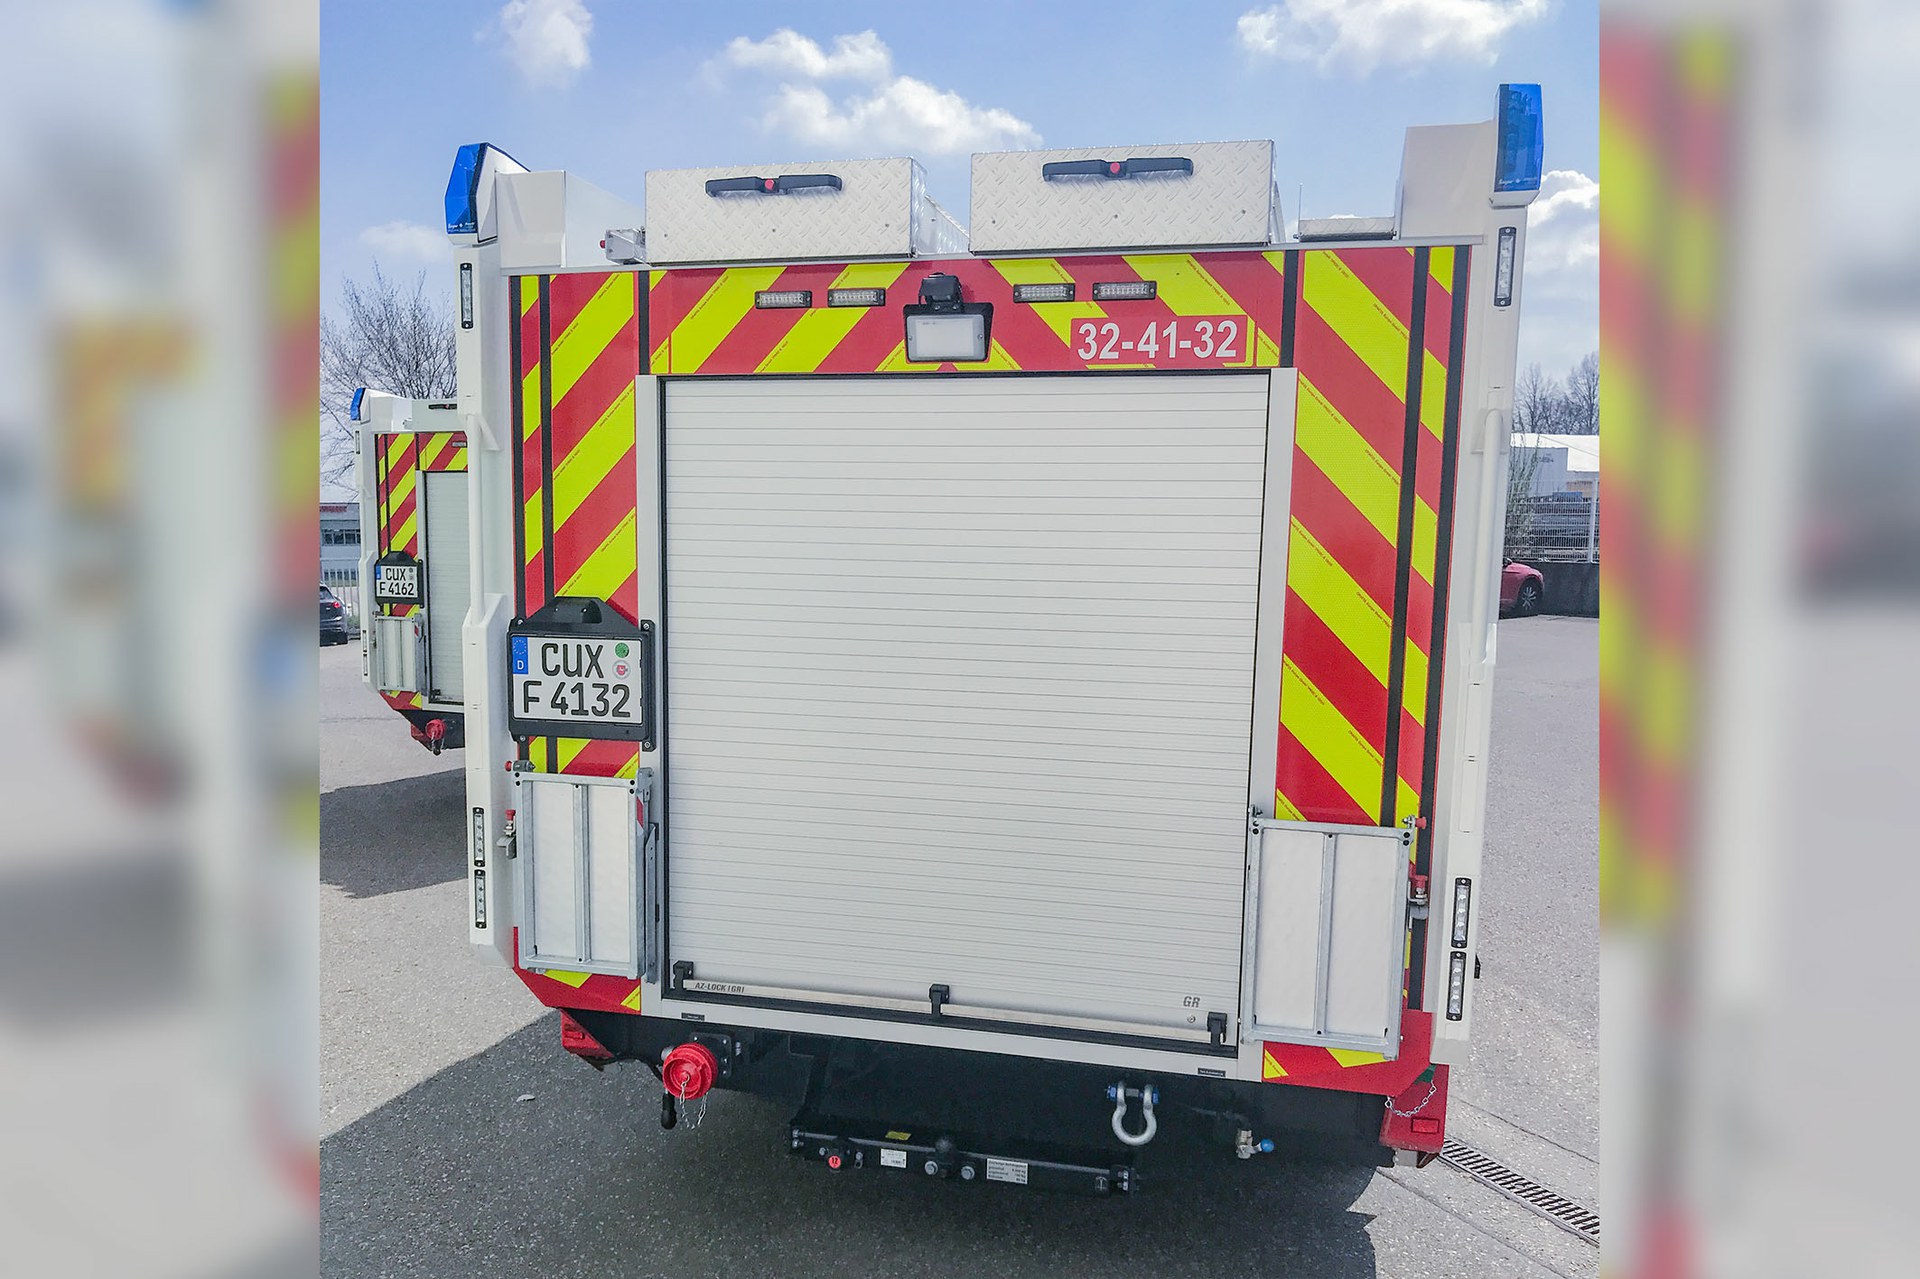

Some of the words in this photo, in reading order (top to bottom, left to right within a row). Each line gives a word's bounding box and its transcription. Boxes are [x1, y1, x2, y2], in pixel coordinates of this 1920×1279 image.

[1077, 320, 1238, 360] 32-41-32
[385, 567, 406, 581] CUX
[379, 581, 386, 595] F
[388, 582, 415, 596] 4162
[517, 660, 525, 671] D
[541, 642, 604, 679] CUX
[523, 680, 543, 713] F
[550, 681, 631, 718] 4132
[694, 982, 727, 992] AZ-LOCK
[1183, 996, 1200, 1008] GR
